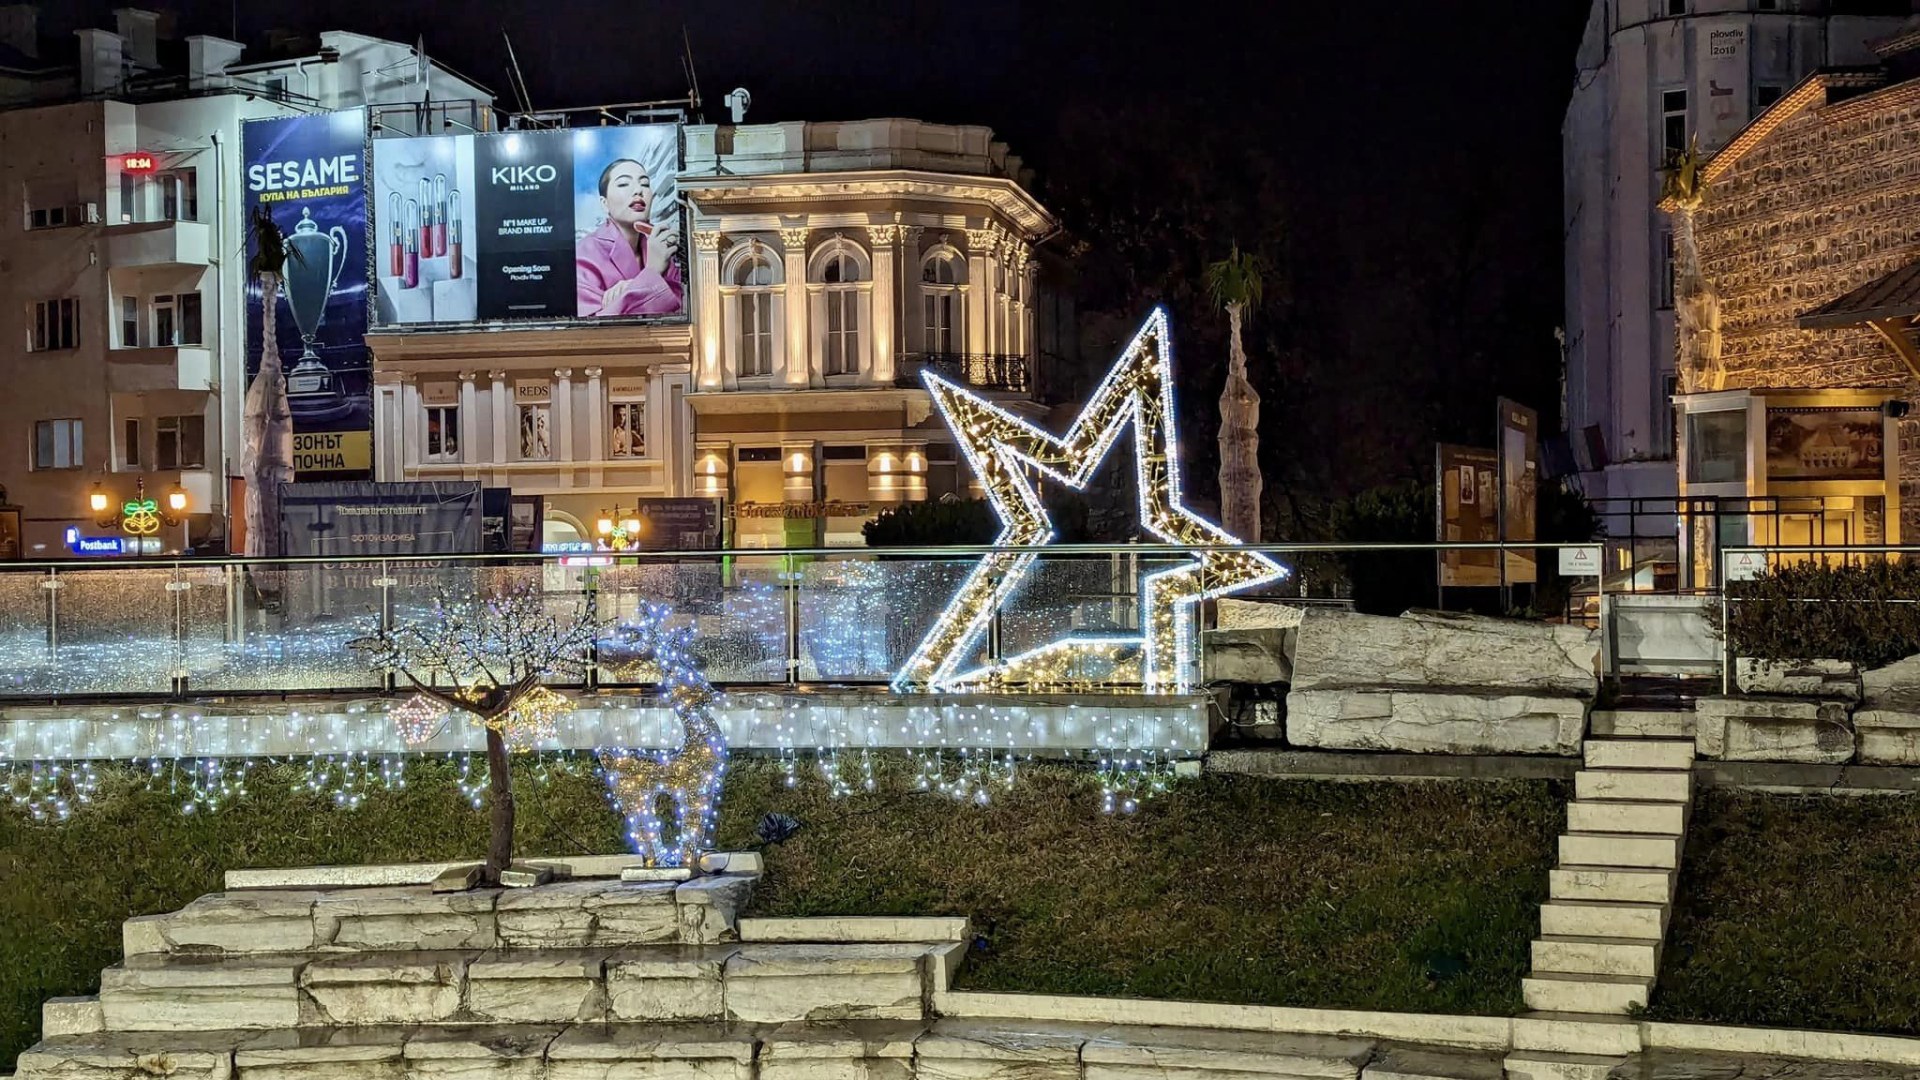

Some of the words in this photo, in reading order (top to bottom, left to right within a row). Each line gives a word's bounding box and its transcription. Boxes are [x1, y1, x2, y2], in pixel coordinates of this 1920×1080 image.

[249, 155, 357, 191] SESAME
[491, 165, 557, 185] KIKO
[260, 191, 285, 203] КУПА
[286, 190, 300, 200] НА
[301, 185, 349, 199] БЪЛГАРИЯ
[516, 218, 537, 226] MAKE
[537, 217, 548, 226] UP
[498, 227, 523, 235] BRAND
[523, 226, 533, 234] IN
[533, 225, 553, 234] ITALY
[502, 265, 532, 274] Opening
[532, 264, 551, 272] Soon
[519, 385, 549, 398] REDS
[293, 434, 343, 451] ЗОНЪТ
[293, 453, 345, 469] ПОЧНА
[80, 540, 118, 551] Postbank
